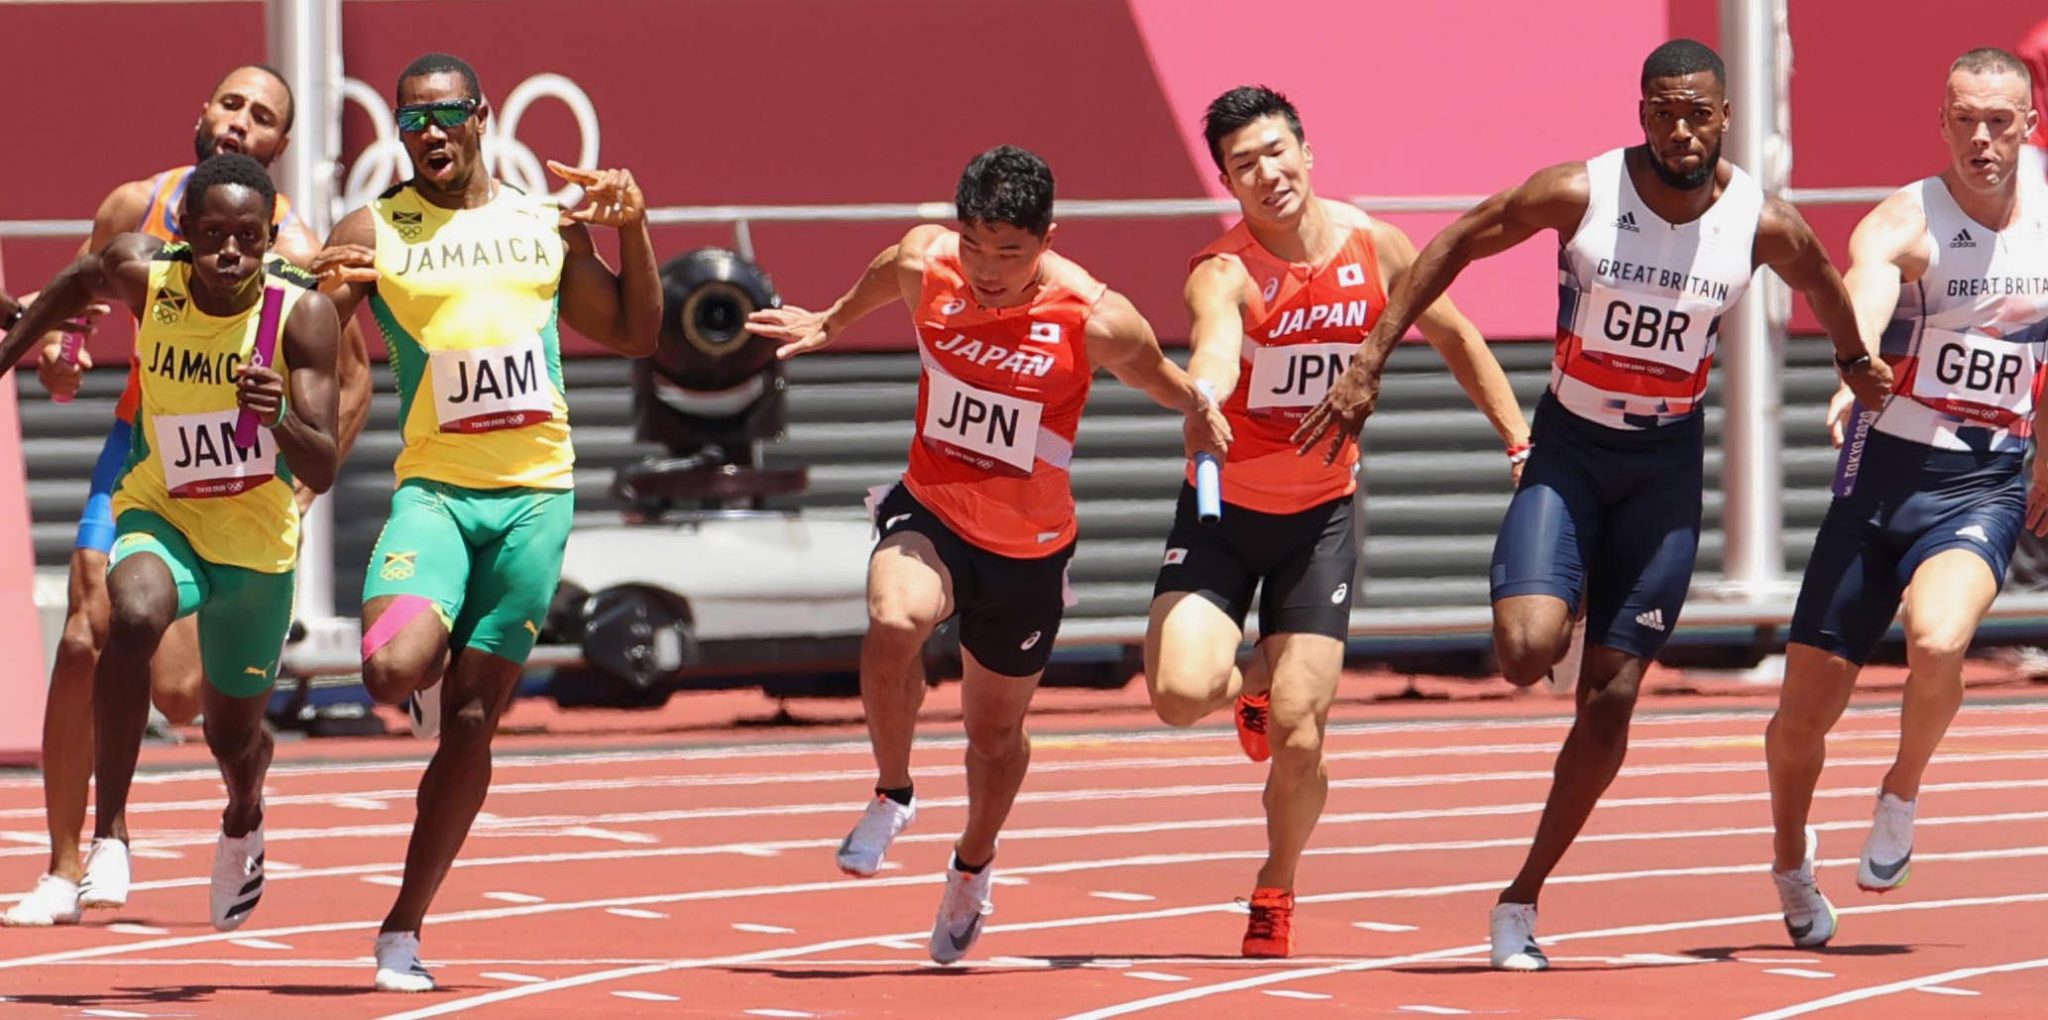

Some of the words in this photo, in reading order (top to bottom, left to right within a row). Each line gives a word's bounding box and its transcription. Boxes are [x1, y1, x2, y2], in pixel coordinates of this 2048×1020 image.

[396, 238, 549, 276] JAMAICA
[1597, 258, 1656, 283] GREAT
[1659, 269, 1729, 301] BRITAIN
[1947, 277, 2000, 297] GREAT
[2005, 276, 2048, 295] BRITA
[1268, 300, 1367, 339] JAPAN
[1603, 300, 1691, 352] GBR
[148, 341, 242, 385] JAMAIC
[447, 350, 538, 404] JAM
[934, 334, 1055, 378] JAPAN
[1936, 343, 2023, 395] GBR
[938, 391, 1019, 448] JPN
[1854, 411, 1872, 440] 2020
[174, 421, 262, 468] JAM
[1844, 440, 1865, 478] TOKYO
